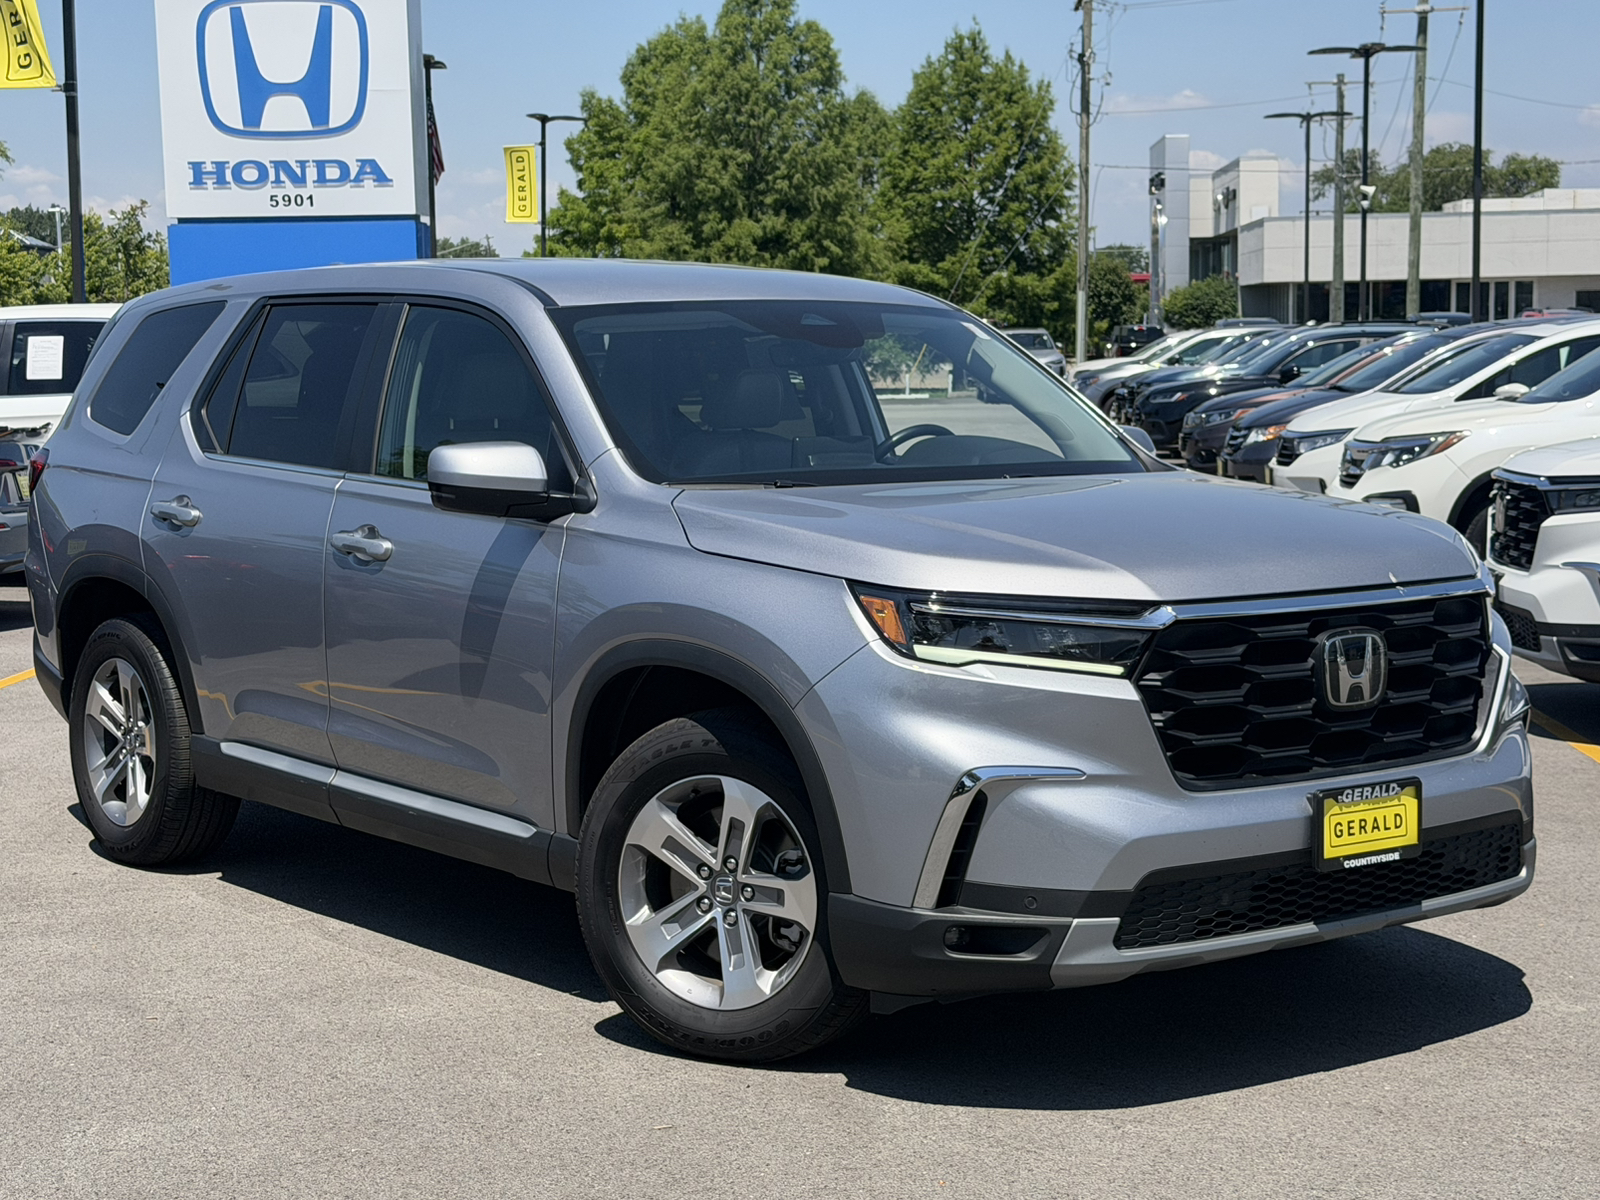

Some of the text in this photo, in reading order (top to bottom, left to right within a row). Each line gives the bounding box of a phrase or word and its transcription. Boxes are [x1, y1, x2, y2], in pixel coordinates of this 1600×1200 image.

[187, 158, 393, 190] HONDA
[514, 155, 527, 213] GERALD
[268, 193, 316, 208] 5901
[1342, 783, 1398, 803] GERALD
[1333, 813, 1404, 839] GERALD
[1343, 851, 1401, 869] COUNTRYSIDE
